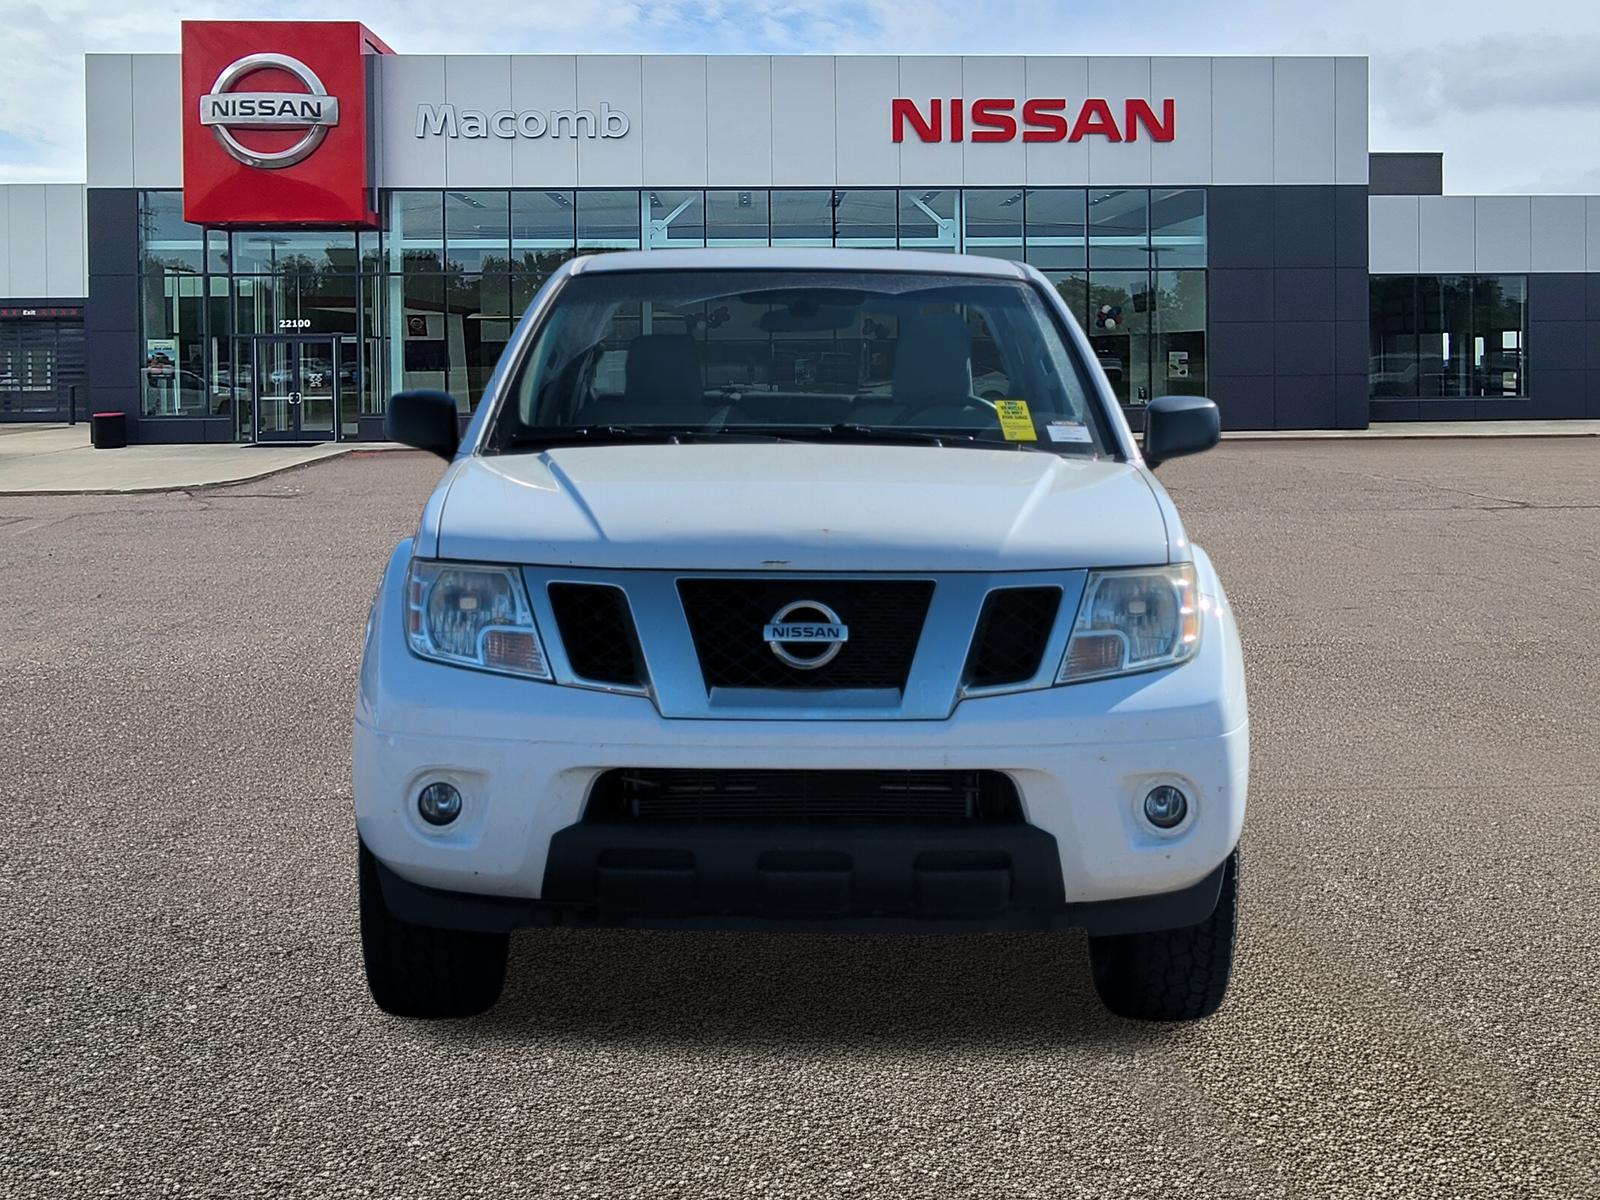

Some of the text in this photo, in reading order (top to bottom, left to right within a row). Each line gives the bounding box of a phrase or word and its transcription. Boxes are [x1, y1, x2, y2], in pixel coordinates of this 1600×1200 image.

[212, 100, 322, 118] NISSAN
[415, 102, 630, 138] Macomb
[892, 98, 1175, 142] NISSAN
[279, 319, 311, 328] 22100
[772, 626, 840, 638] NISSAN
